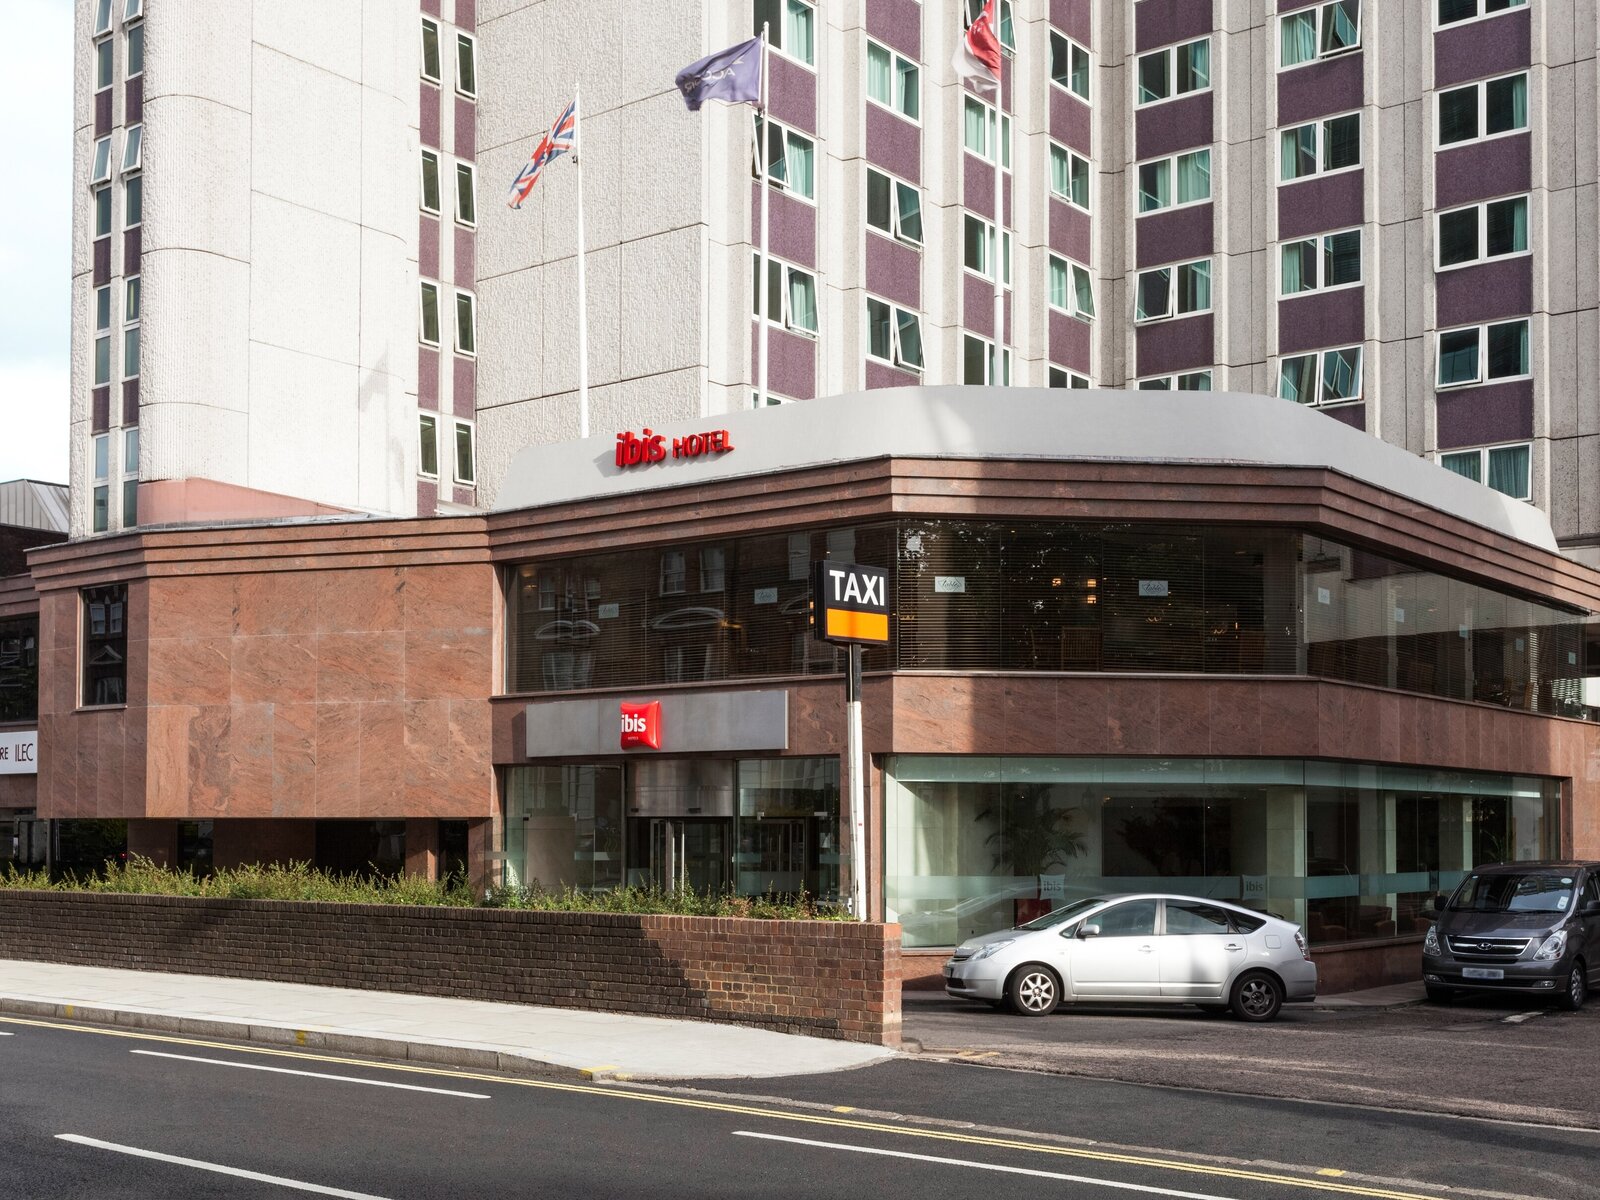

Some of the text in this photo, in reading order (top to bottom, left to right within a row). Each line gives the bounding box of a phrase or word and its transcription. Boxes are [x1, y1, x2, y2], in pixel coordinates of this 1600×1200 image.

[615, 428, 735, 467] ibis HOTEL
[829, 569, 885, 607] TAXI
[621, 713, 647, 733] ibis
[1043, 880, 1061, 891] ibis
[1245, 879, 1264, 891] ibis
